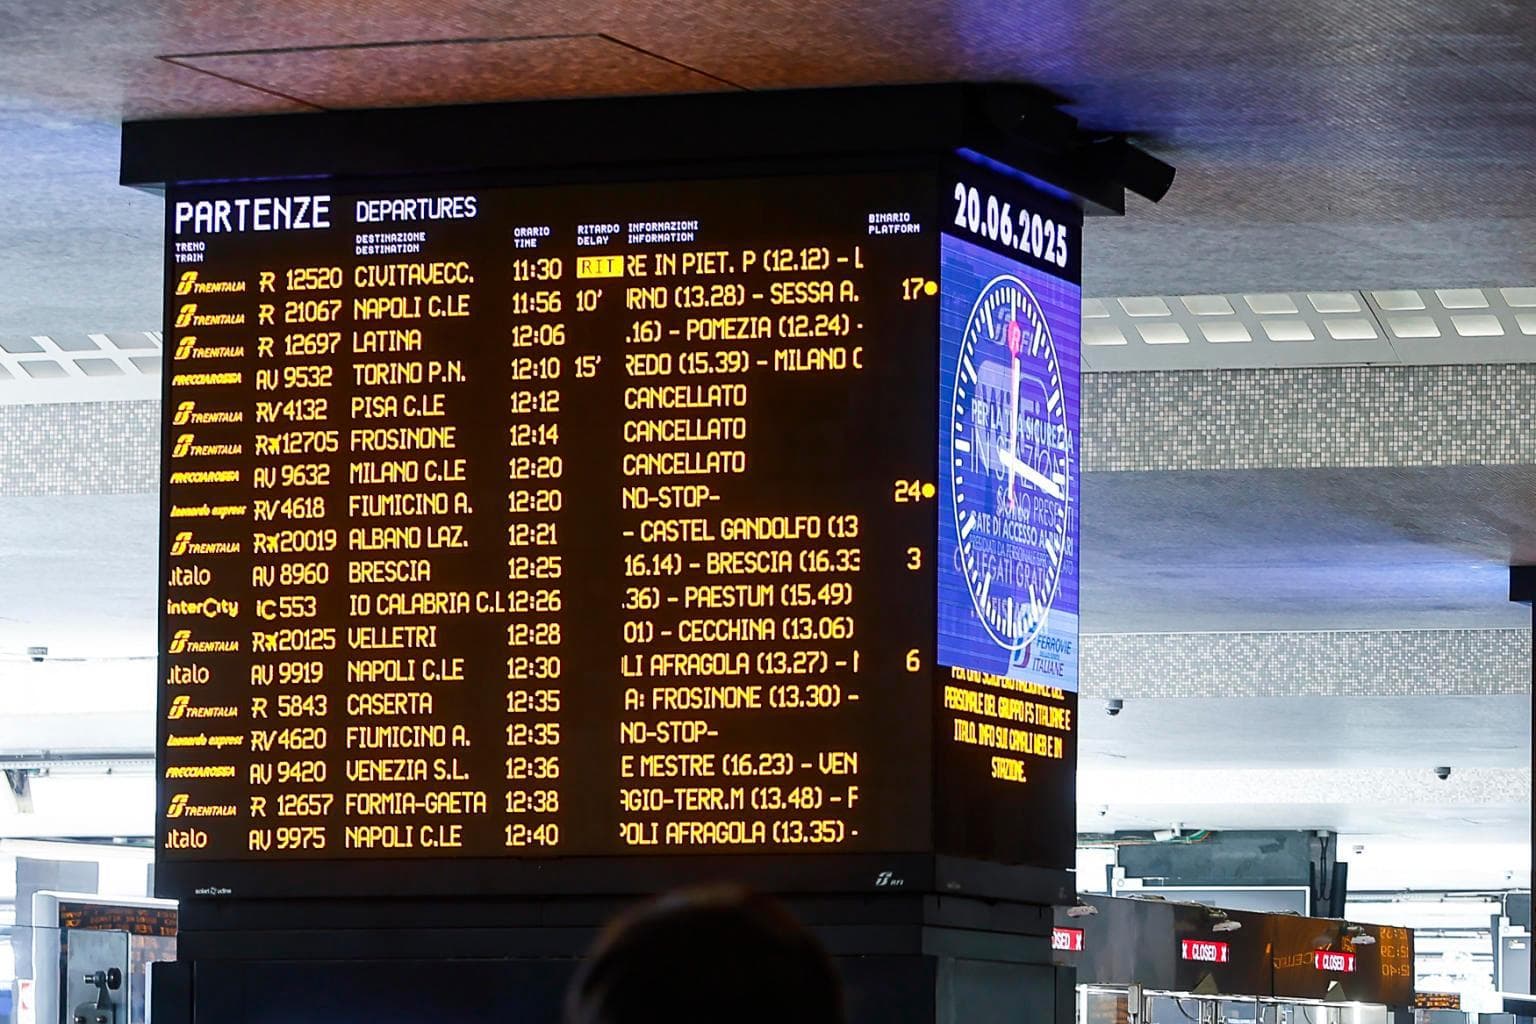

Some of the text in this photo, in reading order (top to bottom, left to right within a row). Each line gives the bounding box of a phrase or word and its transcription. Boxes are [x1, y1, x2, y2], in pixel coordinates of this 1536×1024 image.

[176, 196, 330, 234] PARTENZE
[357, 197, 476, 222] DEPARTURES
[868, 212, 910, 224] BINARIO
[355, 231, 426, 244] DESTINAZIONE
[514, 226, 550, 238] ORARIO
[577, 224, 620, 236] RITARDO
[628, 220, 699, 233] INFORMAZIONI
[628, 232, 694, 244] INFORMATION
[868, 223, 920, 235] PLATFORM
[954, 182, 1068, 268] 20.06.2025
[176, 242, 205, 251] TRENO
[355, 244, 420, 256] DESTINATION
[514, 238, 537, 249] TIME
[577, 236, 609, 247] DELAY
[175, 253, 203, 262] TRAIN
[287, 248, 829, 290] 12520 CIVITAVECC. 11:30 RIT IN PIET. (12.12)
[285, 278, 923, 323] 21067 NAPOLI C.LE 11:56 10' SESSA A. 17
[285, 314, 849, 355] 12697 LATINA 12:06 POMEZIA (12.24)
[284, 356, 601, 388] 9532 TORINO P.N. 12:10 15'
[352, 384, 746, 418] PISA C.LE 12:12 CANCELLATO
[351, 418, 746, 451] FROSINONE 12:14 CANCELLATO
[282, 451, 745, 486] 9632 MILANO C.LE 12:20 CANCELLATO
[350, 481, 921, 516] FIUMICINO 12:20 24
[349, 516, 820, 550] ALBANO LAZ. 12:21 CASTEL GANDOLFO
[280, 548, 921, 585] 8960 BRESCIA 12:25 BRESCIA 3
[280, 583, 852, 617] 553 CALABRIA 12:26 PAESTUM (15.49)
[348, 617, 853, 649] VELLETRI 12:28 CECCHINA (13.06)
[279, 649, 920, 683] 9919 NAPOLI C.LE AFRAGOLA 6
[278, 690, 560, 716] 5843 CASERTA 12:35
[347, 721, 718, 748] FIUMICINO NO-STOP-
[278, 754, 715, 782] 9420 VENEZIA S.L. MESTRE
[277, 792, 486, 816] 12657 FORMIA-GAETA
[277, 824, 558, 849] 9975 NAPOLI C.LE 12:40
[1192, 943, 1217, 961] CLOSED
[1321, 953, 1344, 970] CLOSED
